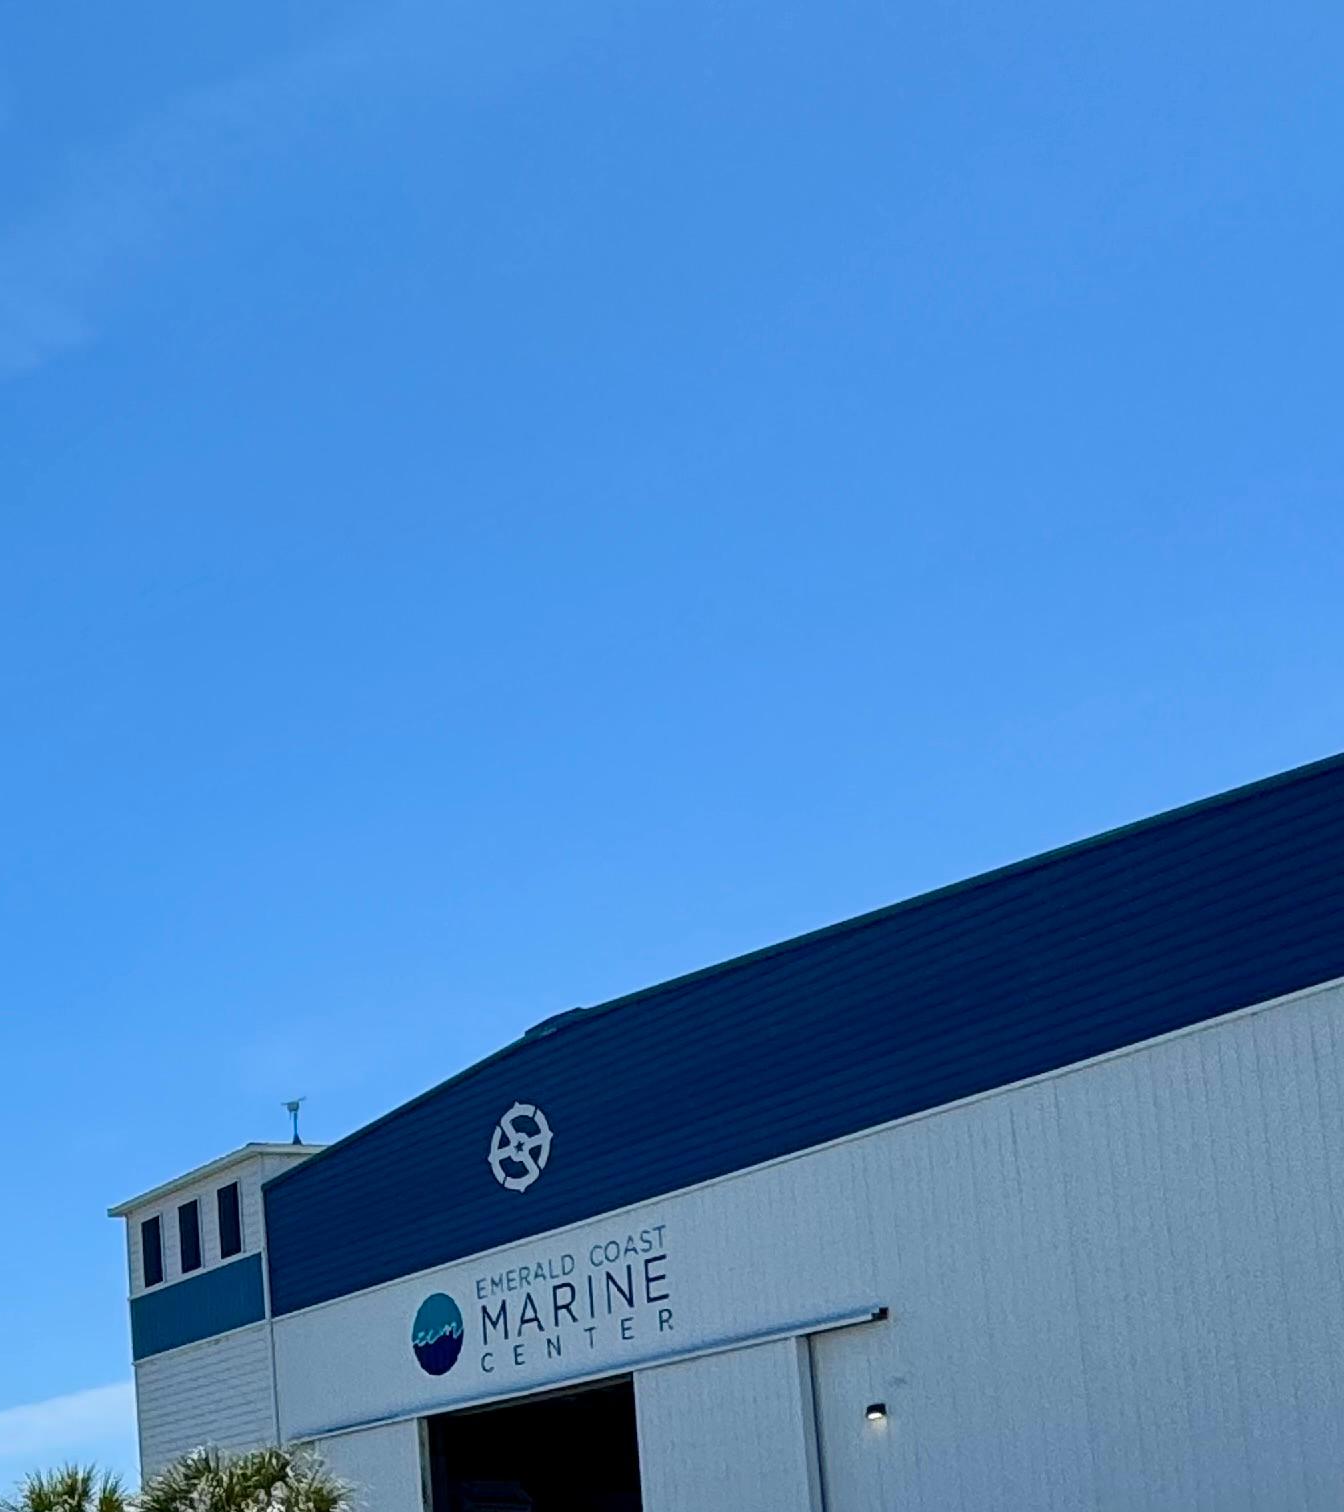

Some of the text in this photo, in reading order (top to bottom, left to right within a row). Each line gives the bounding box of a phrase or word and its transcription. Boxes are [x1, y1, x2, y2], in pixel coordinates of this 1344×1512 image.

[475, 1225, 667, 1300] EMERALD COAST
[480, 1254, 670, 1346] MARINE
[480, 1308, 674, 1373] CENTER
